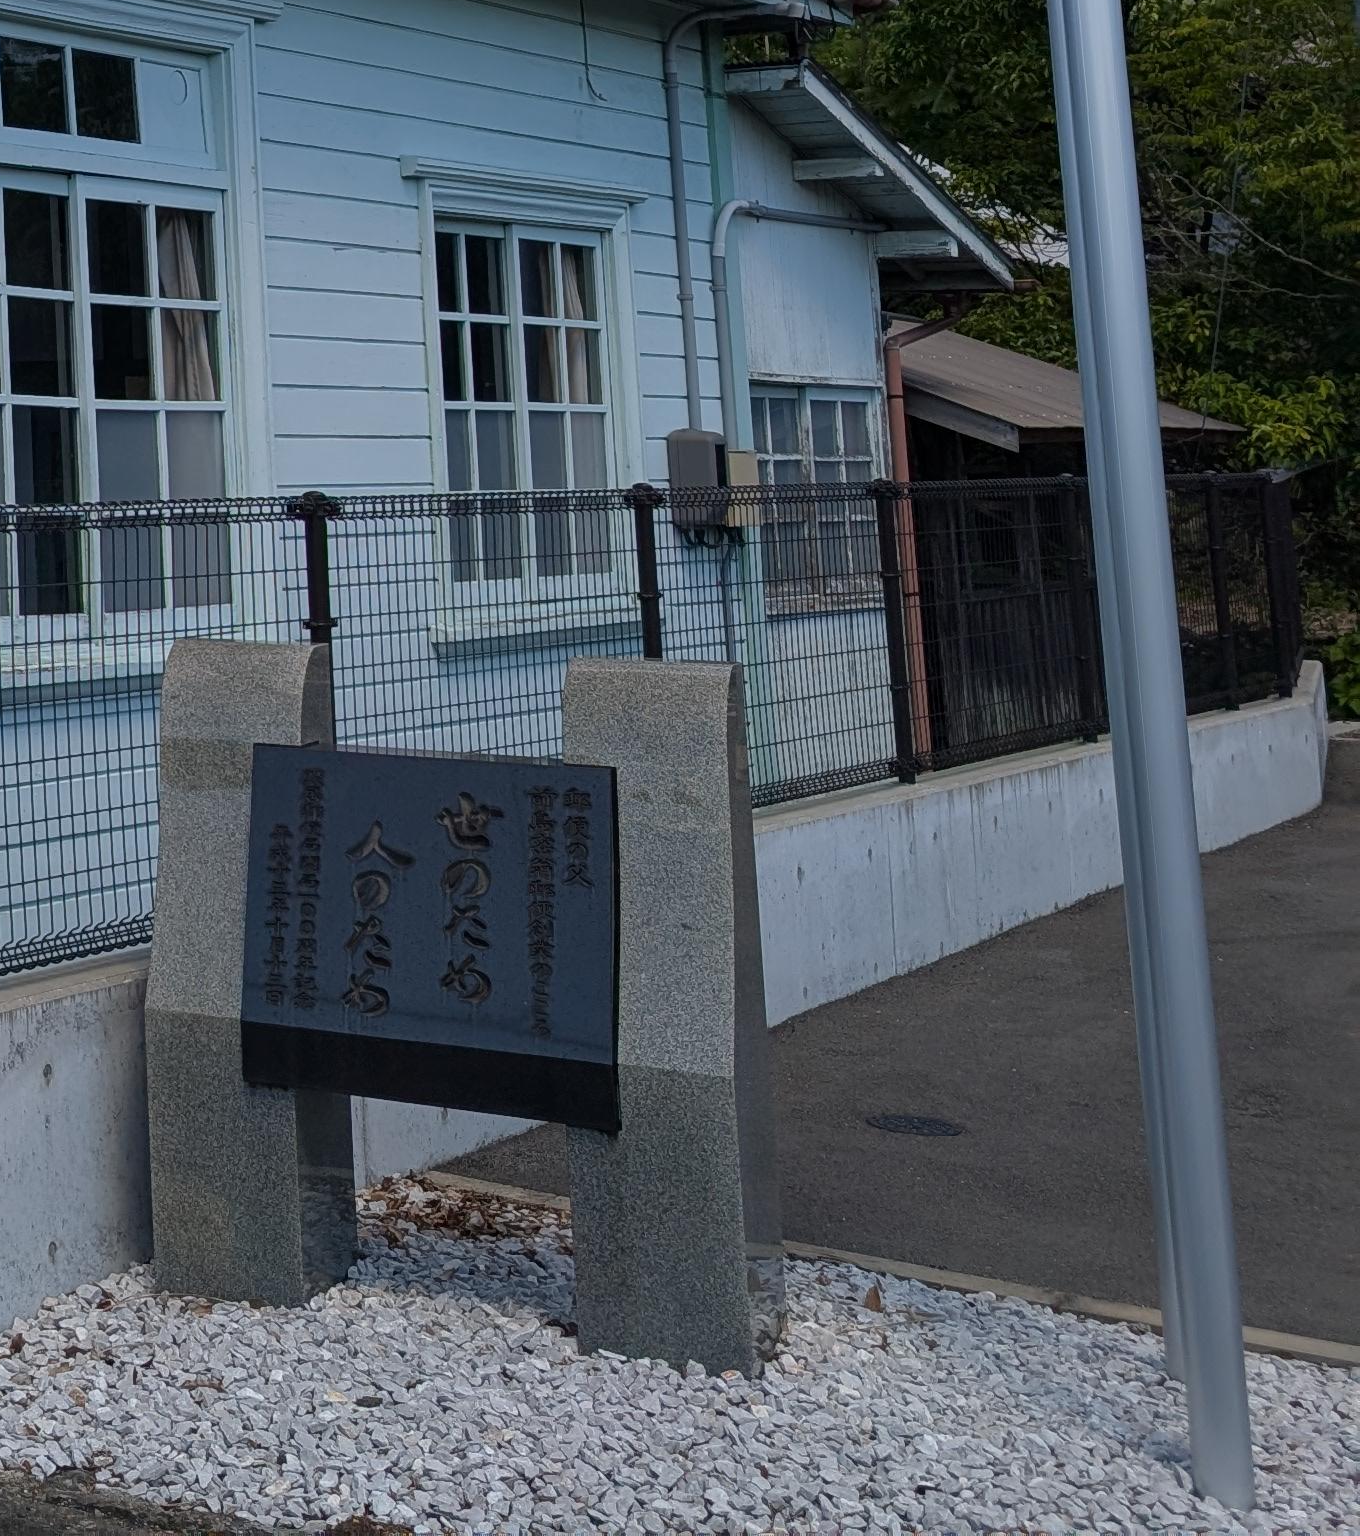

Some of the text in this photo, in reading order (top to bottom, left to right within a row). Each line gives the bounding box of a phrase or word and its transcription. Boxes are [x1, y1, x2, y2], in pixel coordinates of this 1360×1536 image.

[342, 819, 417, 1018] 人のため
[434, 791, 505, 1004] 世のため
[562, 785, 594, 889] 郵便の父
